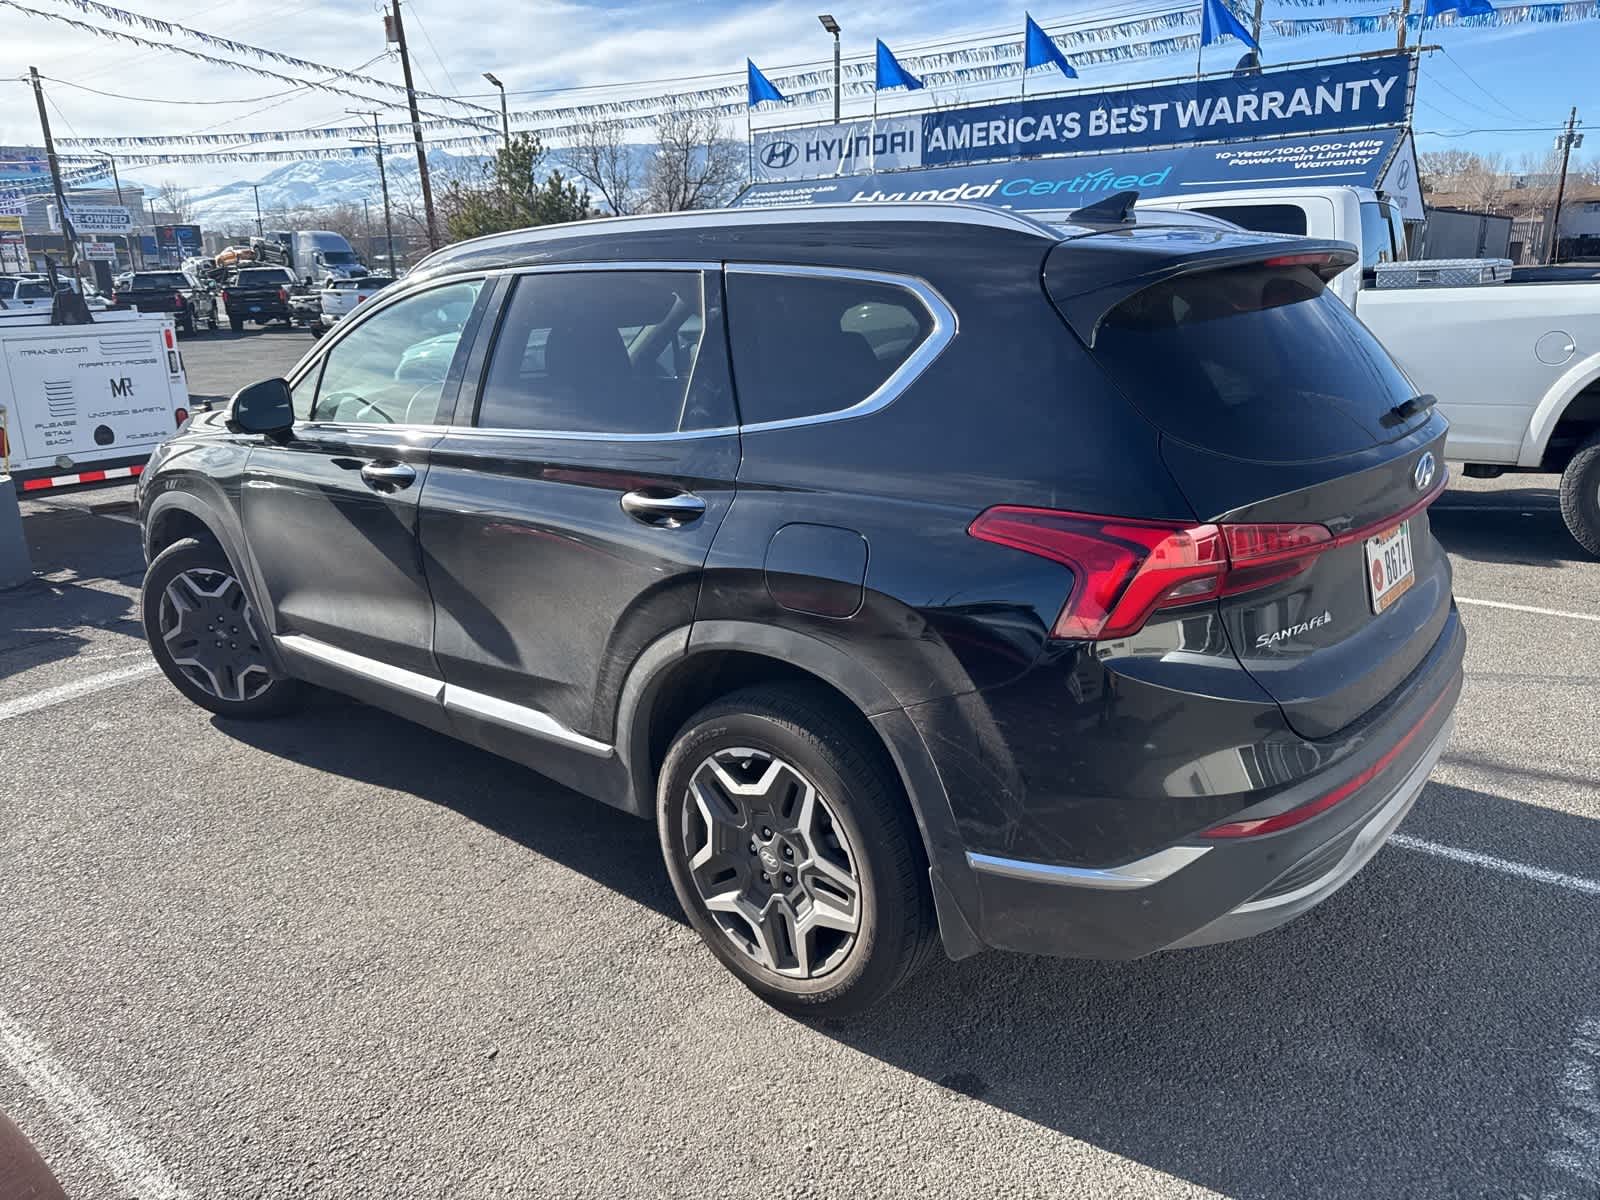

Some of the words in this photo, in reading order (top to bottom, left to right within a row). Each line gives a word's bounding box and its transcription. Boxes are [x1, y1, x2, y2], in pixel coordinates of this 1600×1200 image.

[806, 130, 915, 162] HYUNDAI
[927, 111, 1081, 152] AMERICA'S
[1089, 102, 1170, 137] BEST
[1175, 75, 1398, 129] WARRANTY
[1229, 153, 1316, 166] Powertrain
[1317, 147, 1380, 160] Limited
[1294, 157, 1373, 169] Warranty
[850, 178, 1003, 202] Hyundai
[1001, 166, 1173, 197] Certified
[72, 214, 127, 224] E-OWNED
[110, 377, 134, 398] MR
[34, 420, 77, 429] PLEASE
